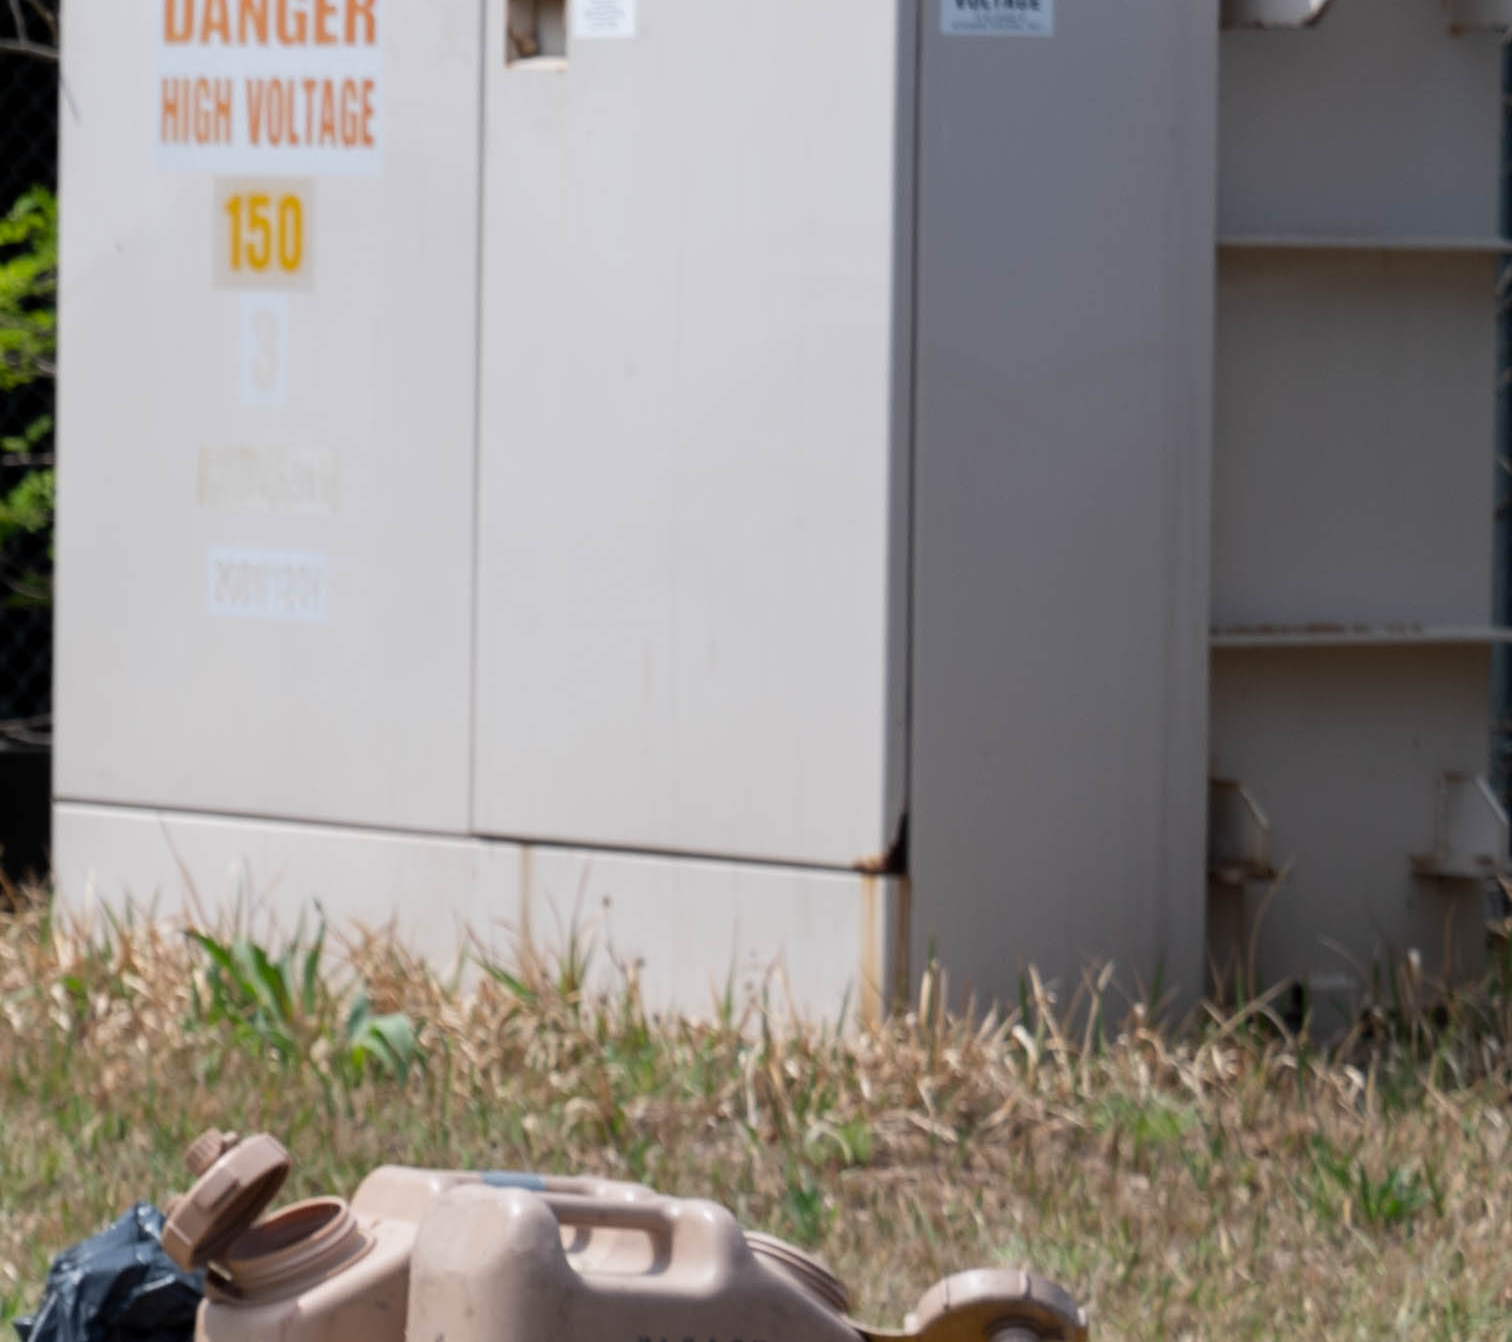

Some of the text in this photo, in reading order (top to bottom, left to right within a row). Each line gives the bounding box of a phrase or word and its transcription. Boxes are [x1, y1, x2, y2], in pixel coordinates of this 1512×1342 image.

[160, 75, 376, 147] HIGH VOLTAGE
[225, 192, 303, 273] 150
